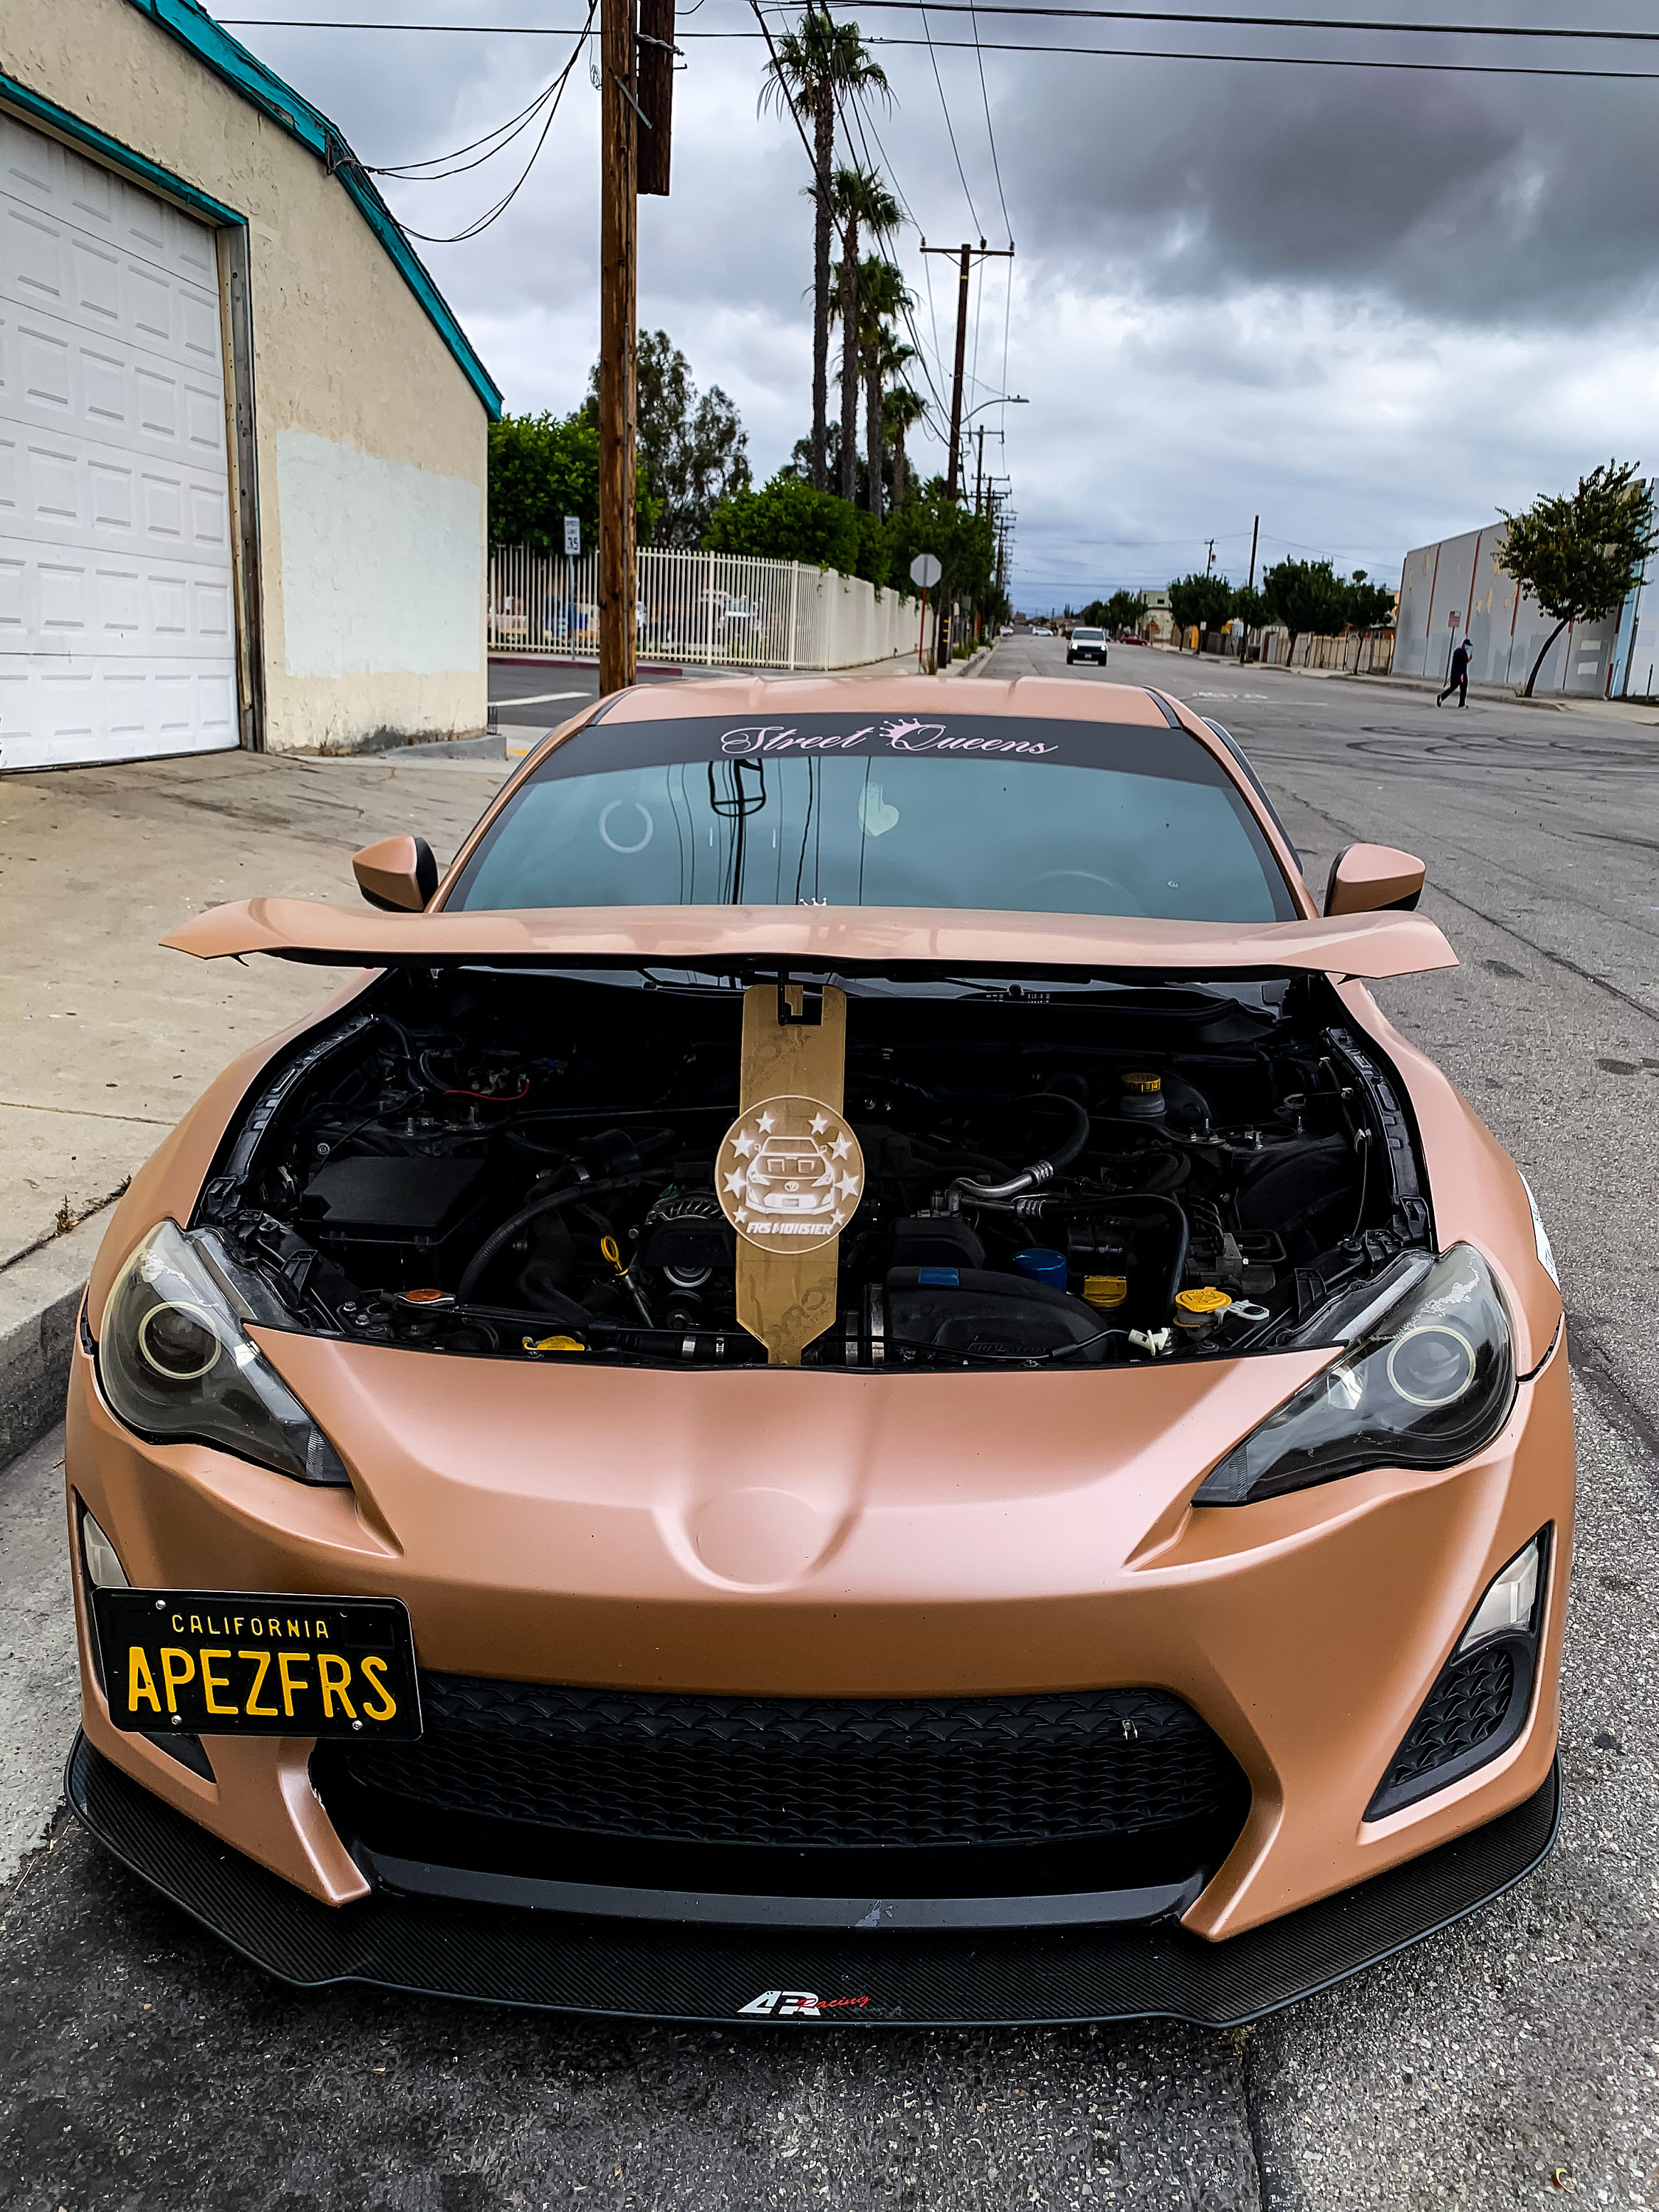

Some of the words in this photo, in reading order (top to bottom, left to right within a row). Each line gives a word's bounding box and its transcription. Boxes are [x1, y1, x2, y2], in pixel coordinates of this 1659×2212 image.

[568, 537, 579, 551] 35
[720, 726, 875, 754] Street
[885, 723, 1060, 755] Queens
[745, 1222, 772, 1234] FRS
[172, 1614, 329, 1638] CALIFORNIA
[128, 1646, 397, 1721] APEZFRS
